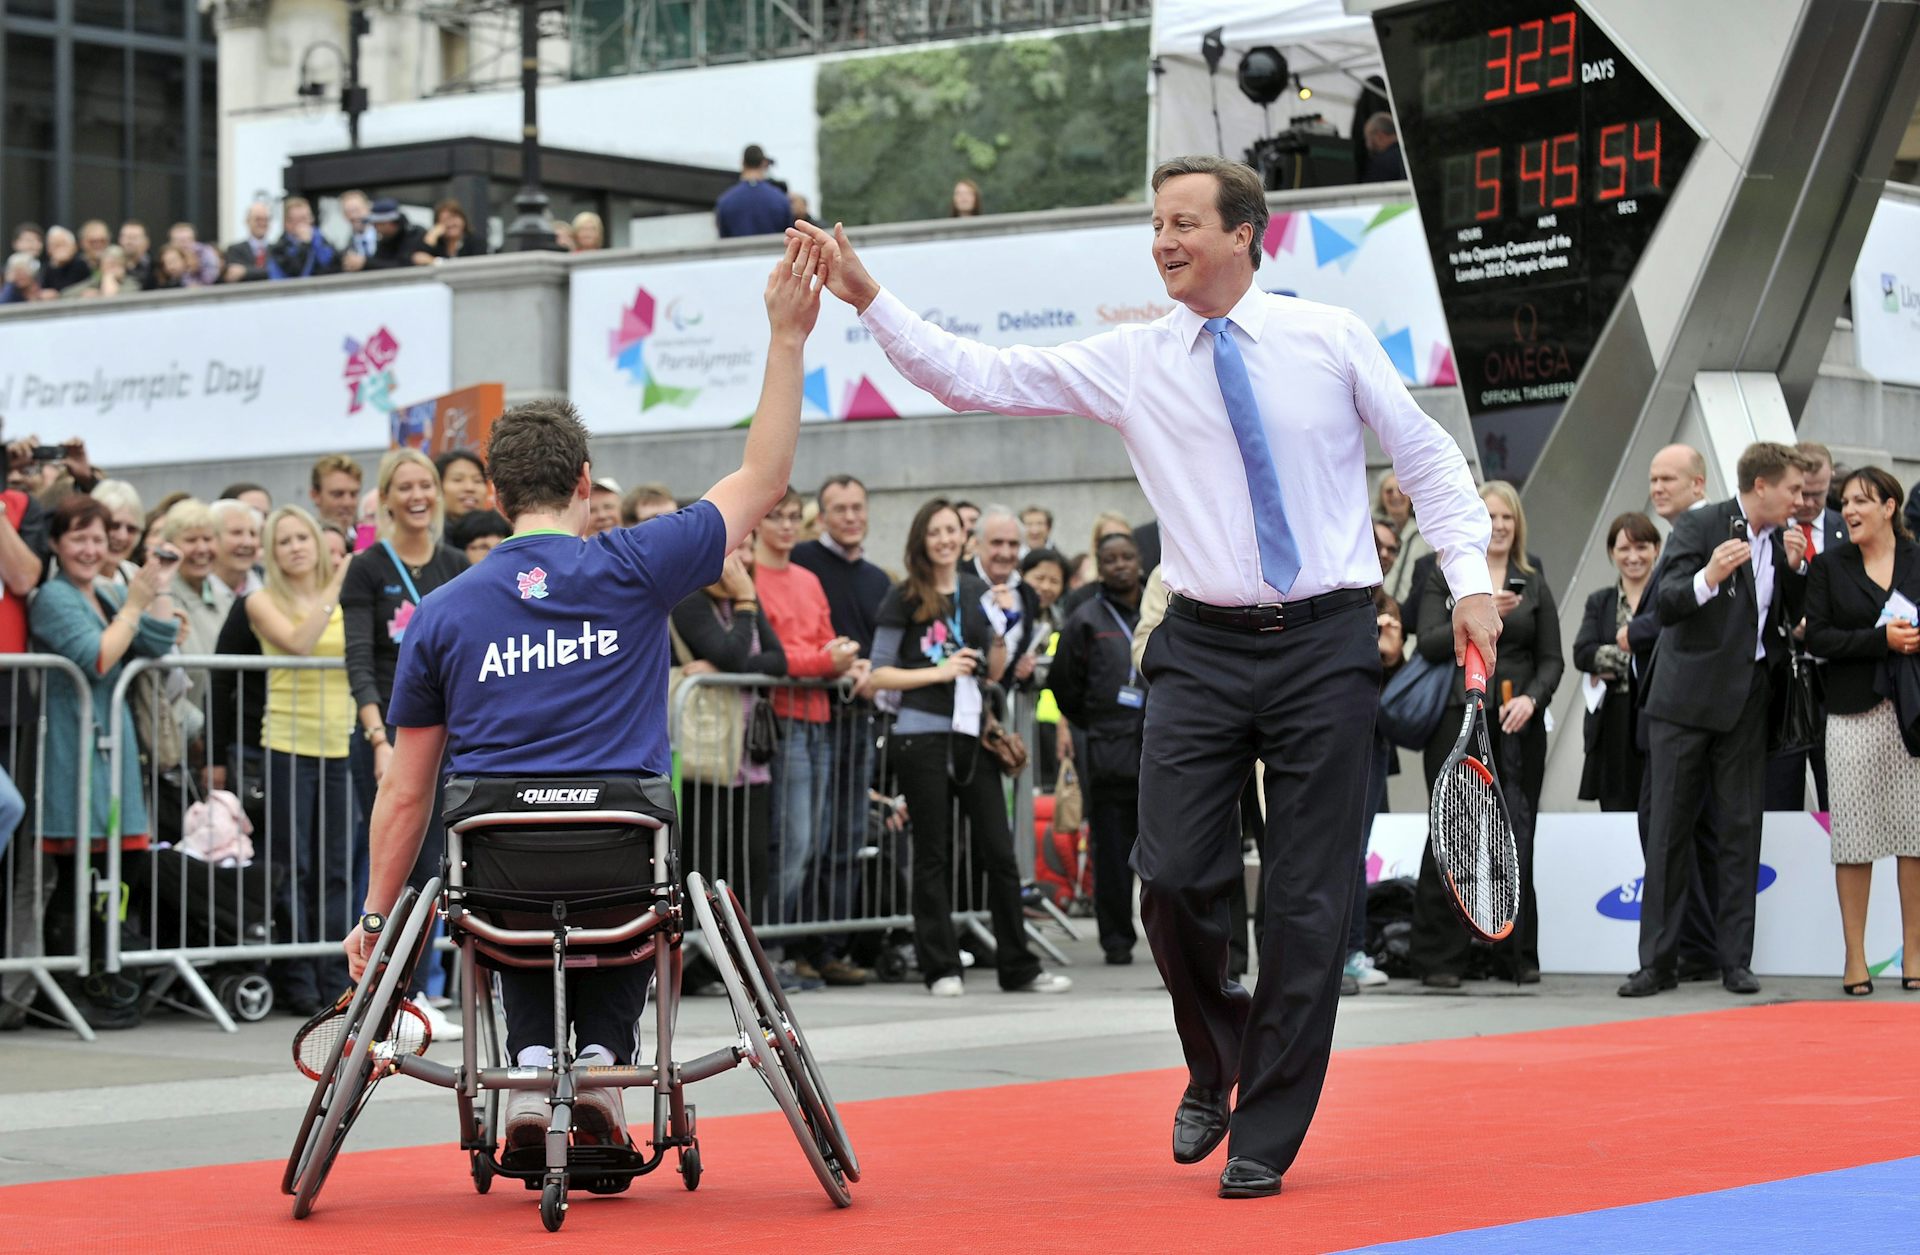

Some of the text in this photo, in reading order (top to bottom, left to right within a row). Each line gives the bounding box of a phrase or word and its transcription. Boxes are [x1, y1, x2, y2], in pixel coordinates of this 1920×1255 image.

[1484, 11, 1616, 101] 323 DAYS
[1475, 120, 1662, 221] 5 45 54
[1537, 213, 1558, 229] MINS
[1617, 199, 1638, 215] SECS
[1457, 226, 1483, 242] HOURS
[1458, 249, 1473, 264] the
[1472, 244, 1507, 263] Opening
[1506, 240, 1547, 256] Ceremony
[1557, 233, 1573, 248] the
[1455, 254, 1569, 282] London 2012 Olympic Games
[657, 346, 753, 375] Paralympic
[1484, 345, 1573, 385] OMEGA
[20, 360, 193, 415] Paralympic
[204, 358, 265, 405] Day
[1480, 387, 1523, 406] OFFICIAL
[477, 620, 619, 682] Athlete
[522, 788, 599, 804] QUICKIE
